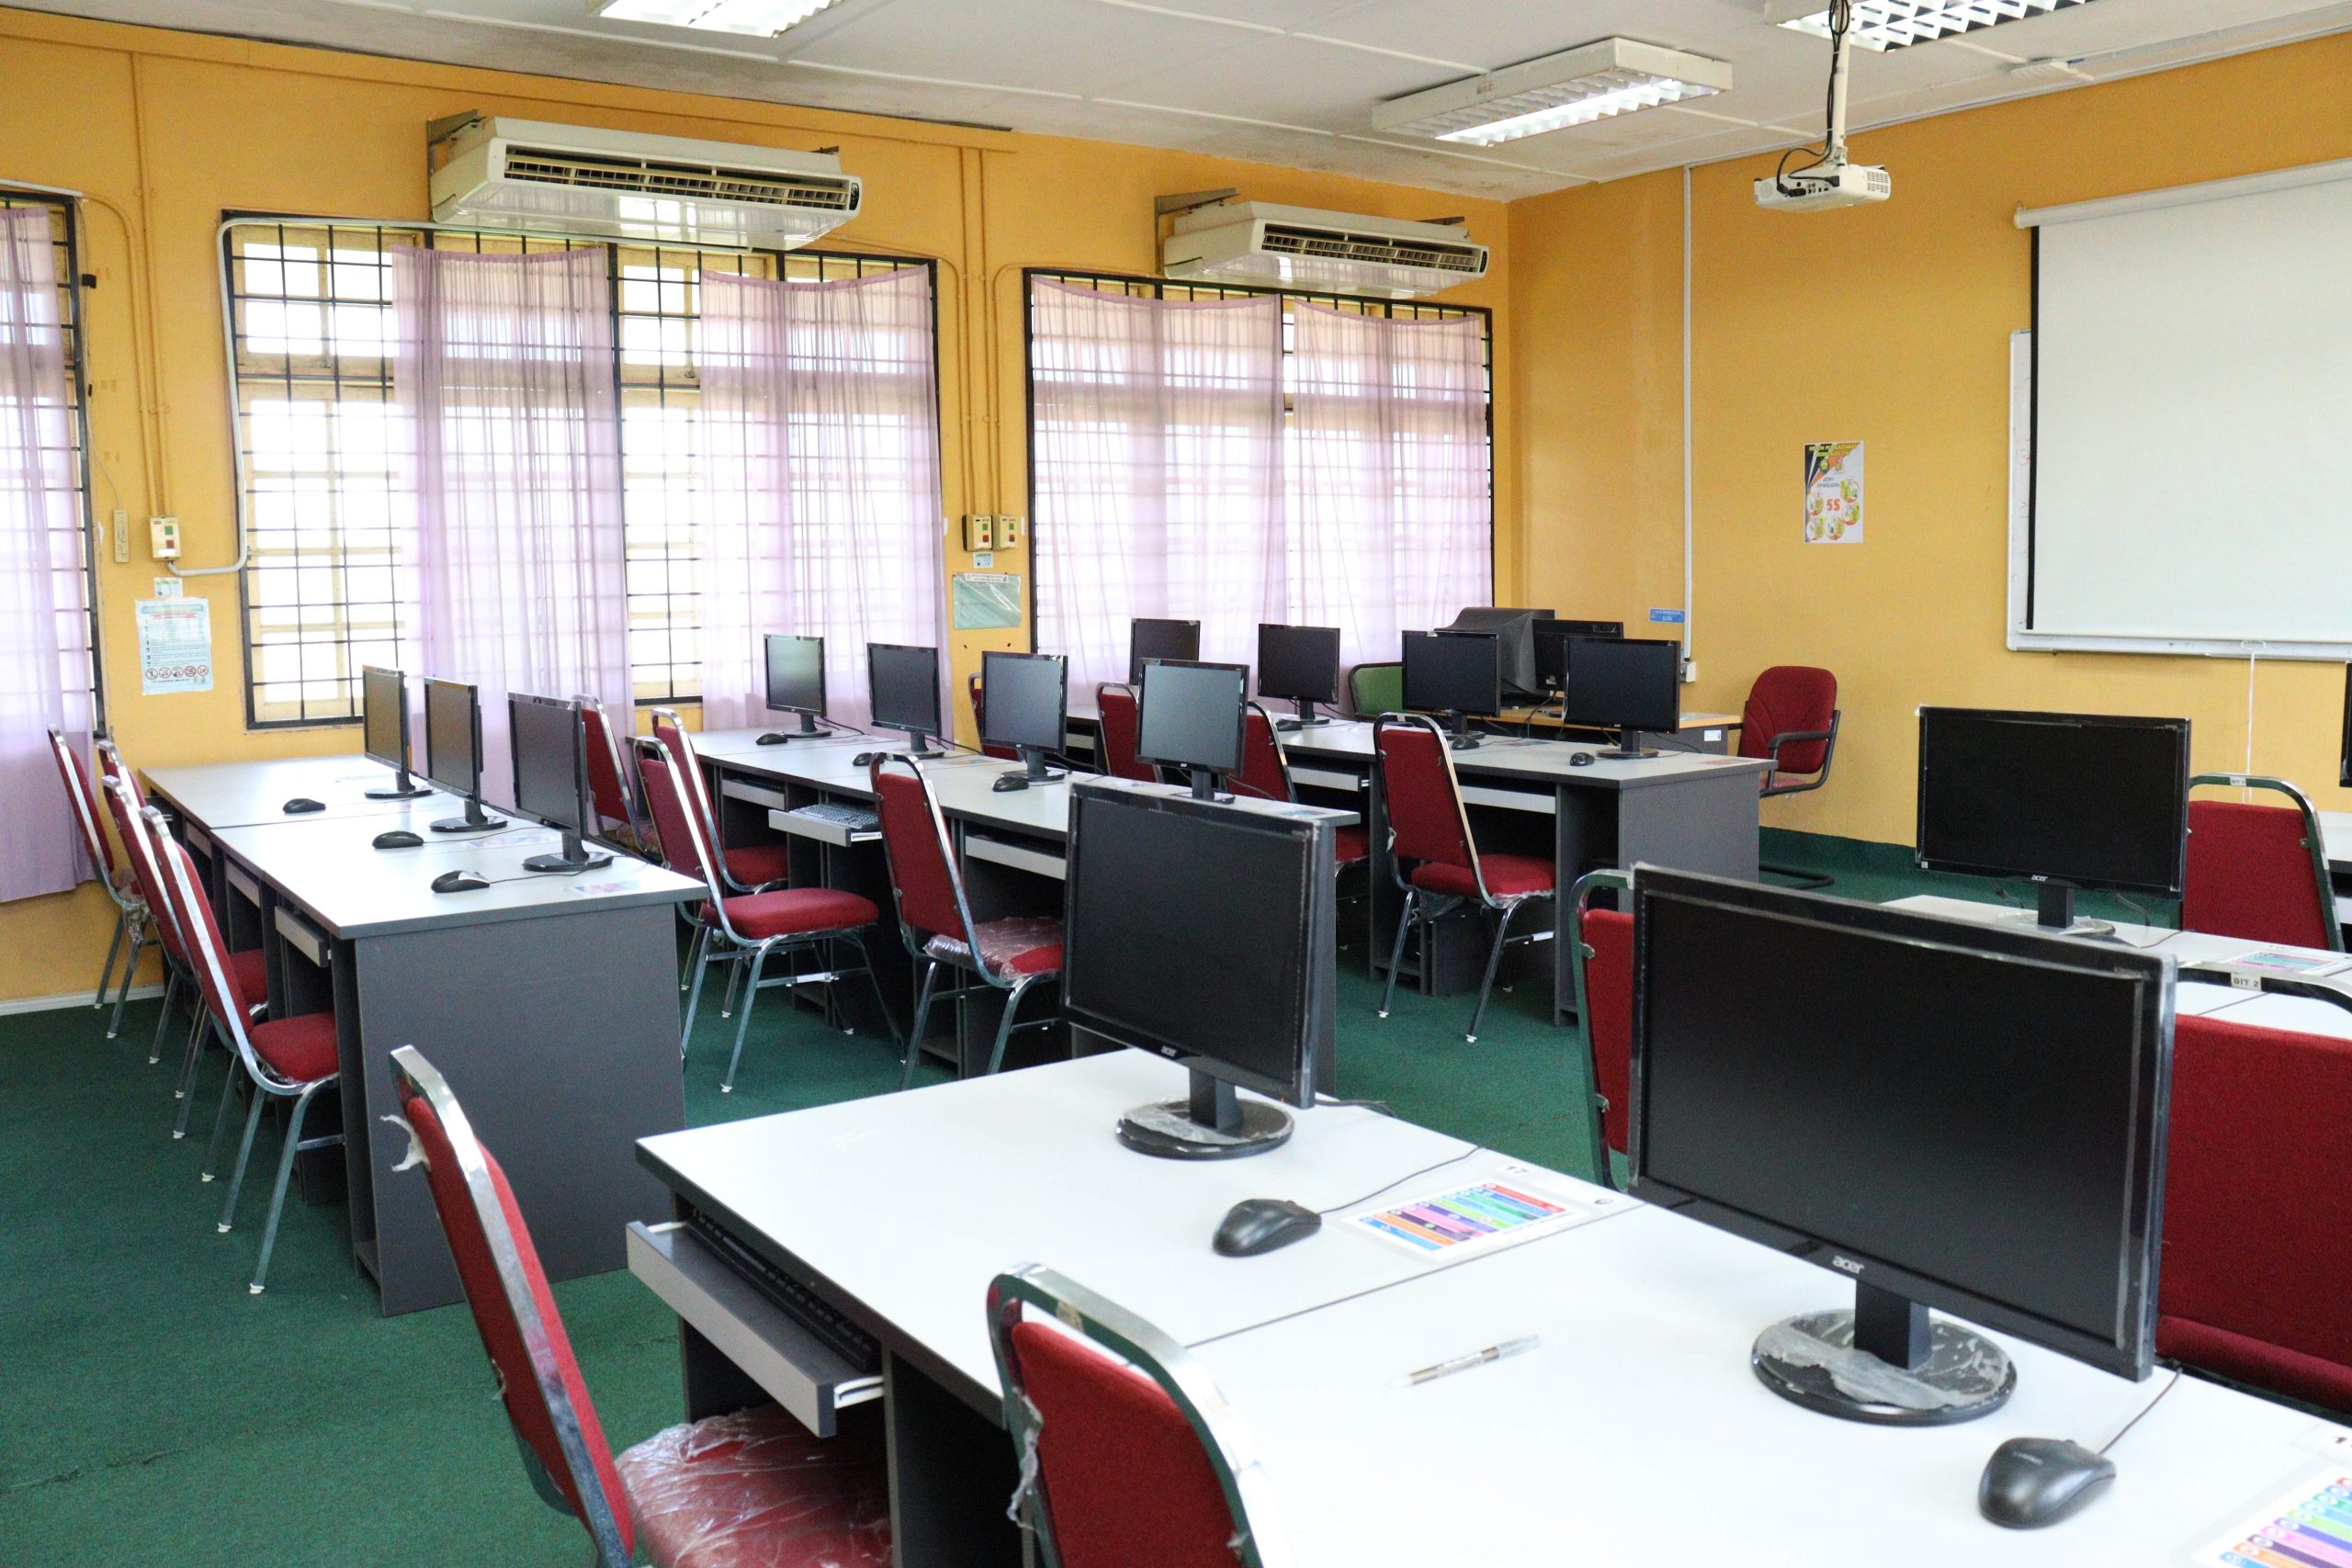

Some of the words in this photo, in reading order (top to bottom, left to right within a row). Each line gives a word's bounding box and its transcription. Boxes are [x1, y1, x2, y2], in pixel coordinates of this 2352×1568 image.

[1826, 499, 1840, 511] 5S
[2233, 977, 2249, 986] BIT
[1833, 1256, 1864, 1274] acer
